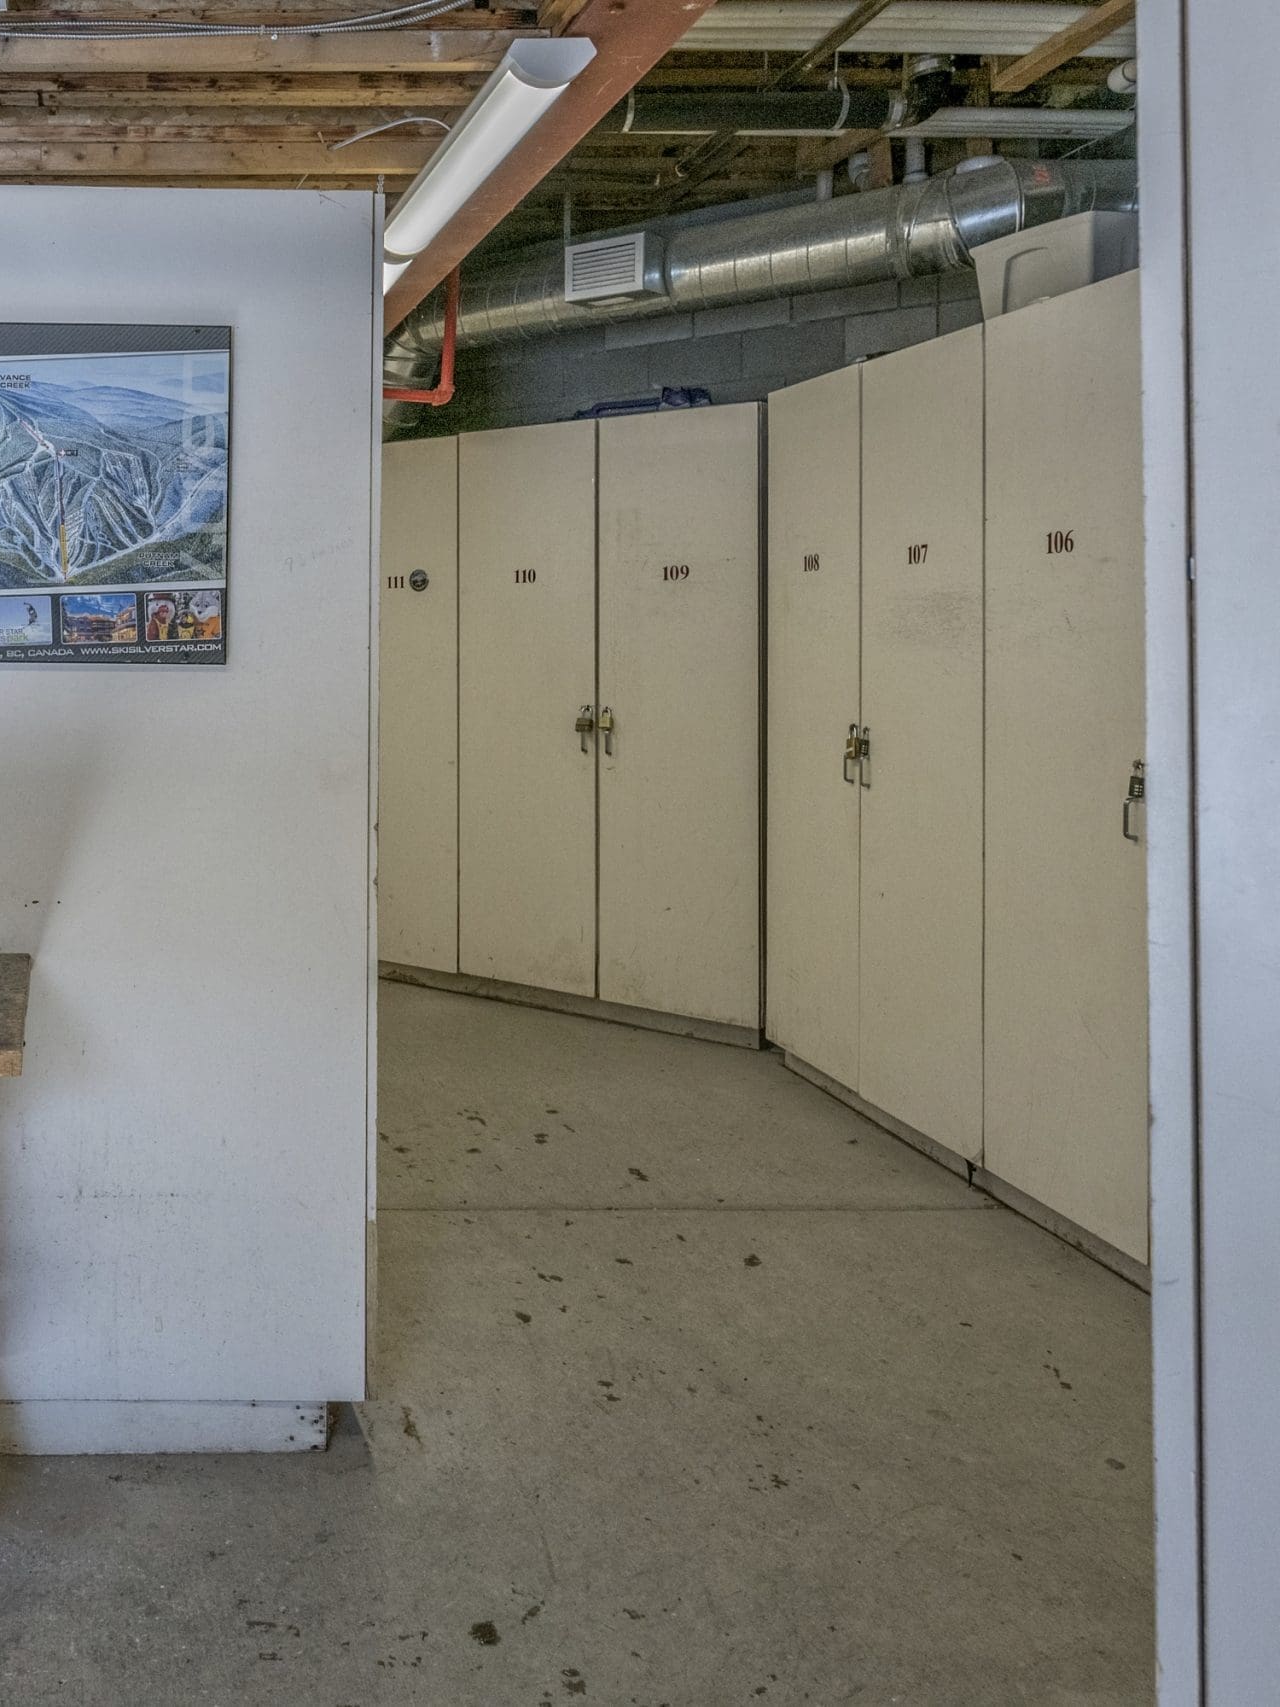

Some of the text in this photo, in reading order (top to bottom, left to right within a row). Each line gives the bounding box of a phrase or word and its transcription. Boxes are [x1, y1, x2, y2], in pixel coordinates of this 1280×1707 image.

[1045, 529, 1075, 554] 106
[907, 544, 928, 565] 107
[803, 554, 820, 572] 108
[513, 568, 536, 584] 110
[662, 565, 690, 581] 109
[387, 576, 405, 589] 111
[6, 650, 25, 659] BC,
[28, 648, 74, 657] CANADA
[80, 643, 221, 655] WWW.SKISILVERSTAR.COM
